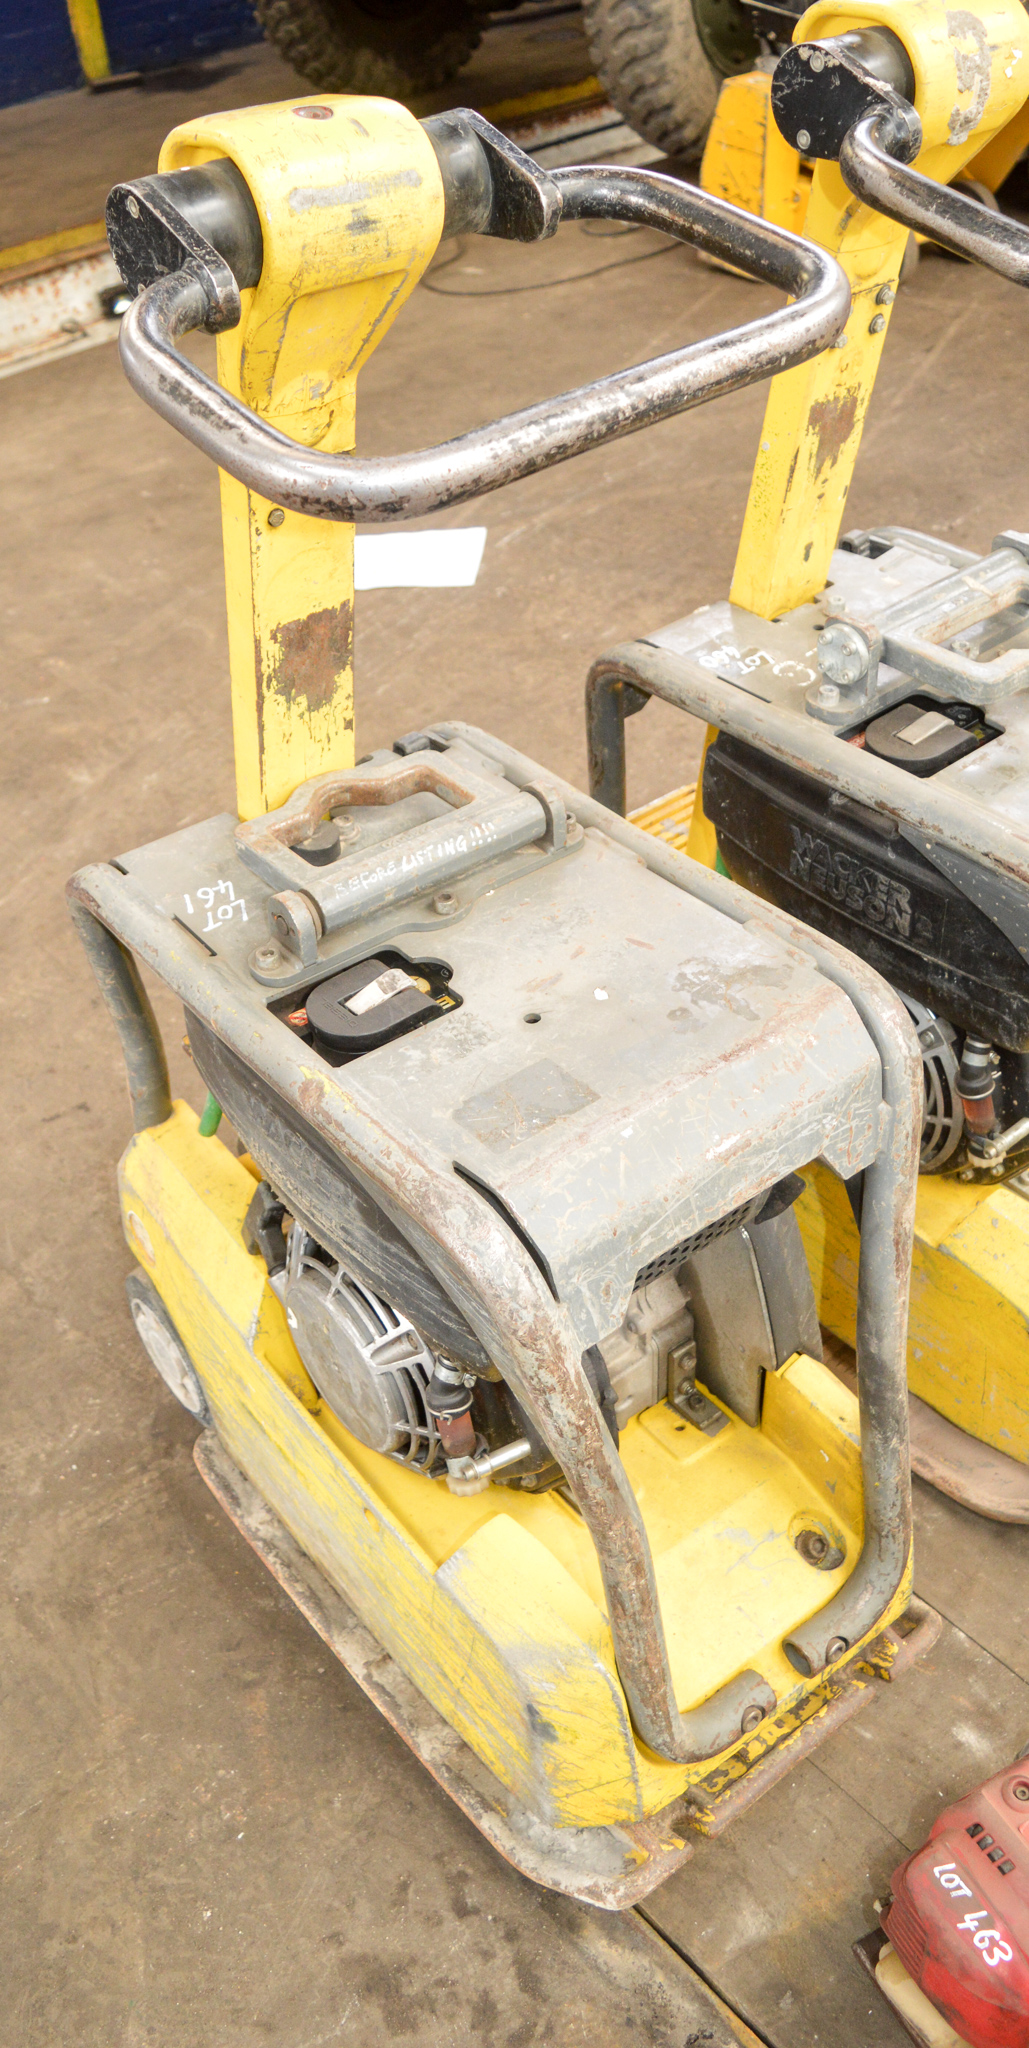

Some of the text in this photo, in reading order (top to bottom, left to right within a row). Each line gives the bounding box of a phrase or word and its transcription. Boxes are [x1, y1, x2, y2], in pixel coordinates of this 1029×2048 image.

[737, 651, 775, 675] LOT
[333, 860, 397, 899] BEFORE
[790, 824, 912, 915] WACKER
[183, 879, 236, 915] 461
[789, 849, 911, 938] NEUSON
[202, 898, 249, 932] LOT
[933, 1862, 1013, 1967] LOT 463
